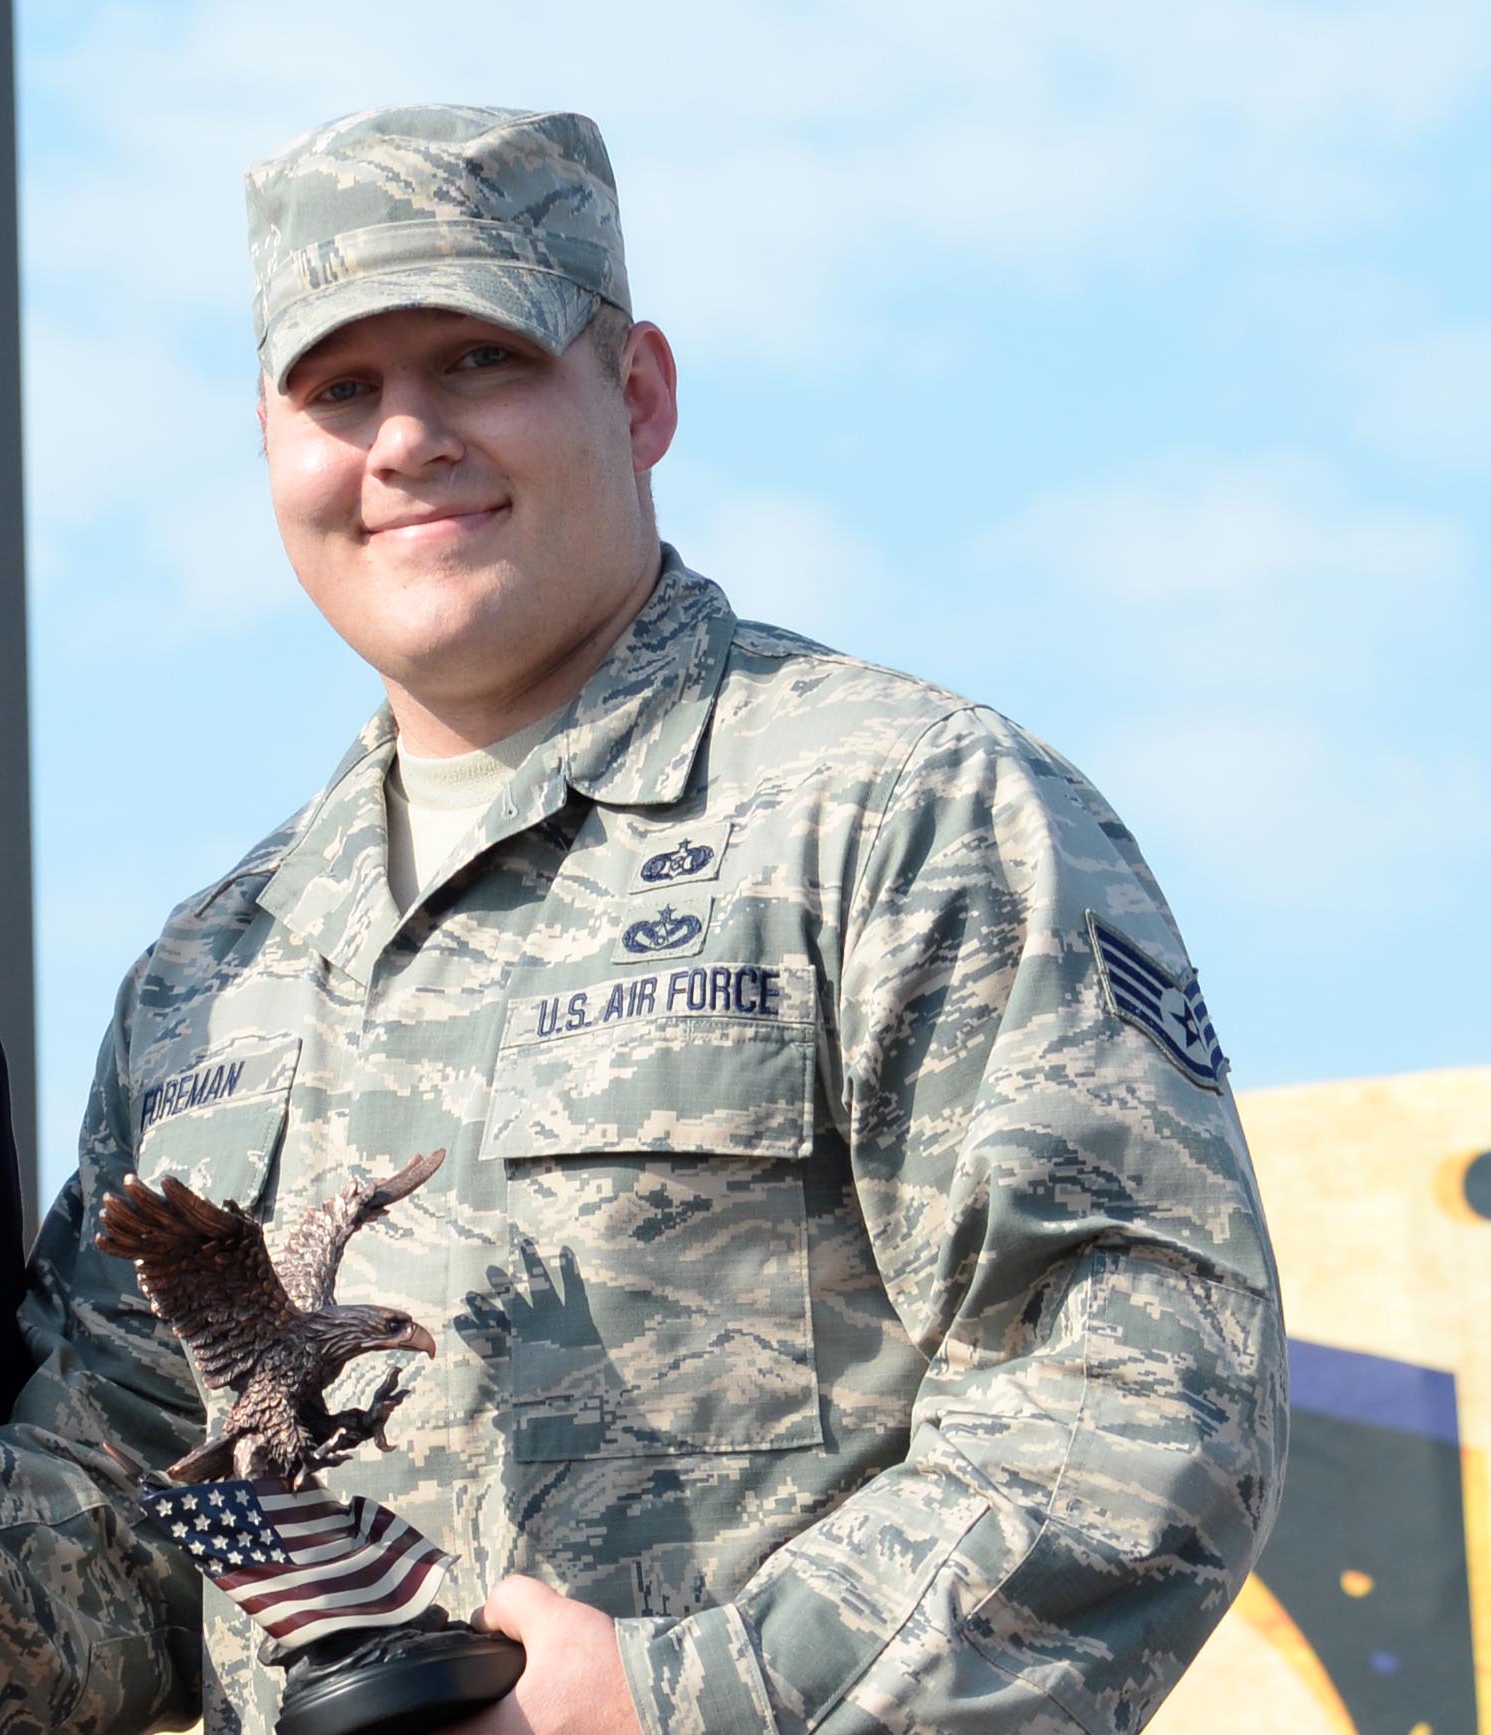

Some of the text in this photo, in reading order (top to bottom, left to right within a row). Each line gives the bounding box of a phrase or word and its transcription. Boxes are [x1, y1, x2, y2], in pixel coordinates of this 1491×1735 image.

[536, 966, 781, 1038] U.S. AIR FORCE
[141, 1060, 246, 1130] FOREMAN
